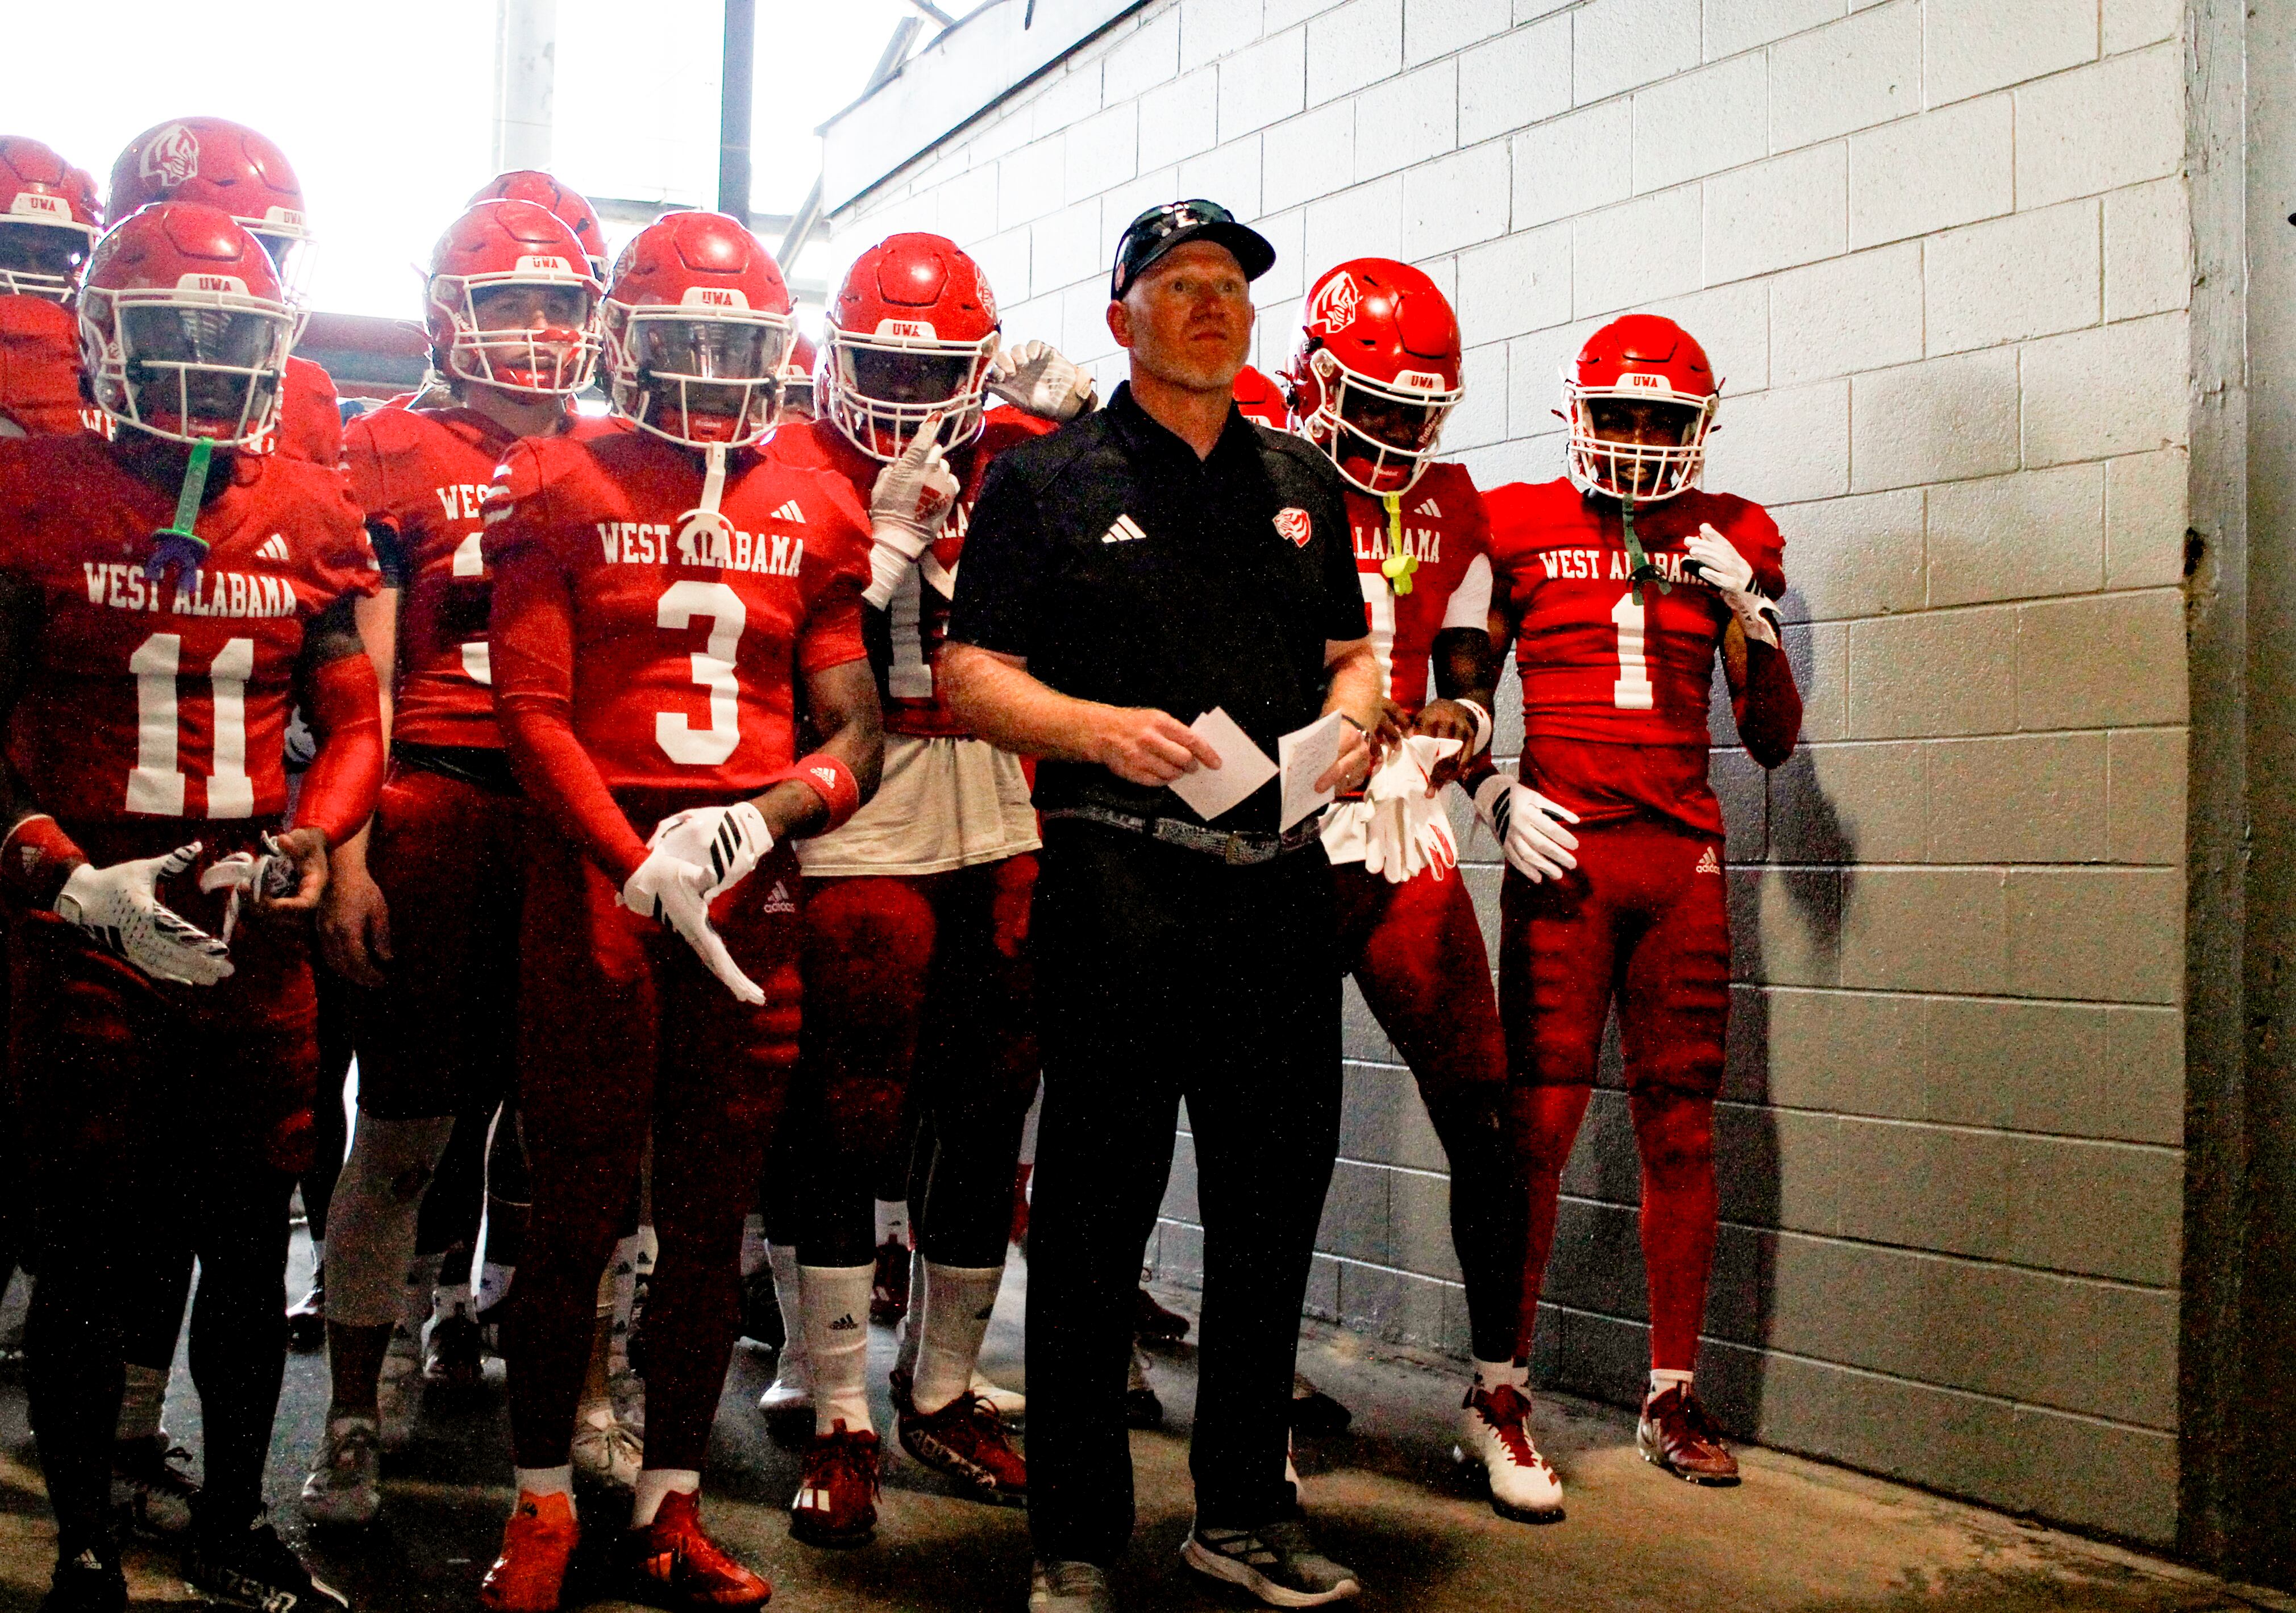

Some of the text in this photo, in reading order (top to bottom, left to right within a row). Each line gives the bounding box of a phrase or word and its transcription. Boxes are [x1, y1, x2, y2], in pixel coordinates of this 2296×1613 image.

[30, 198, 56, 211] UWA
[284, 211, 302, 225] UWA
[533, 257, 559, 269] UWA
[199, 277, 232, 292] UWA
[702, 292, 732, 305] UWA
[893, 323, 920, 336] UWA
[1411, 375, 1433, 388] UWA
[1634, 376, 1658, 387] UWA
[597, 522, 671, 564] WEST
[1538, 550, 1599, 579] WEST
[83, 562, 296, 618] WEST ALABAMA
[1611, 592, 1654, 710] 1
[655, 580, 747, 766] 3
[125, 632, 255, 819] 11
